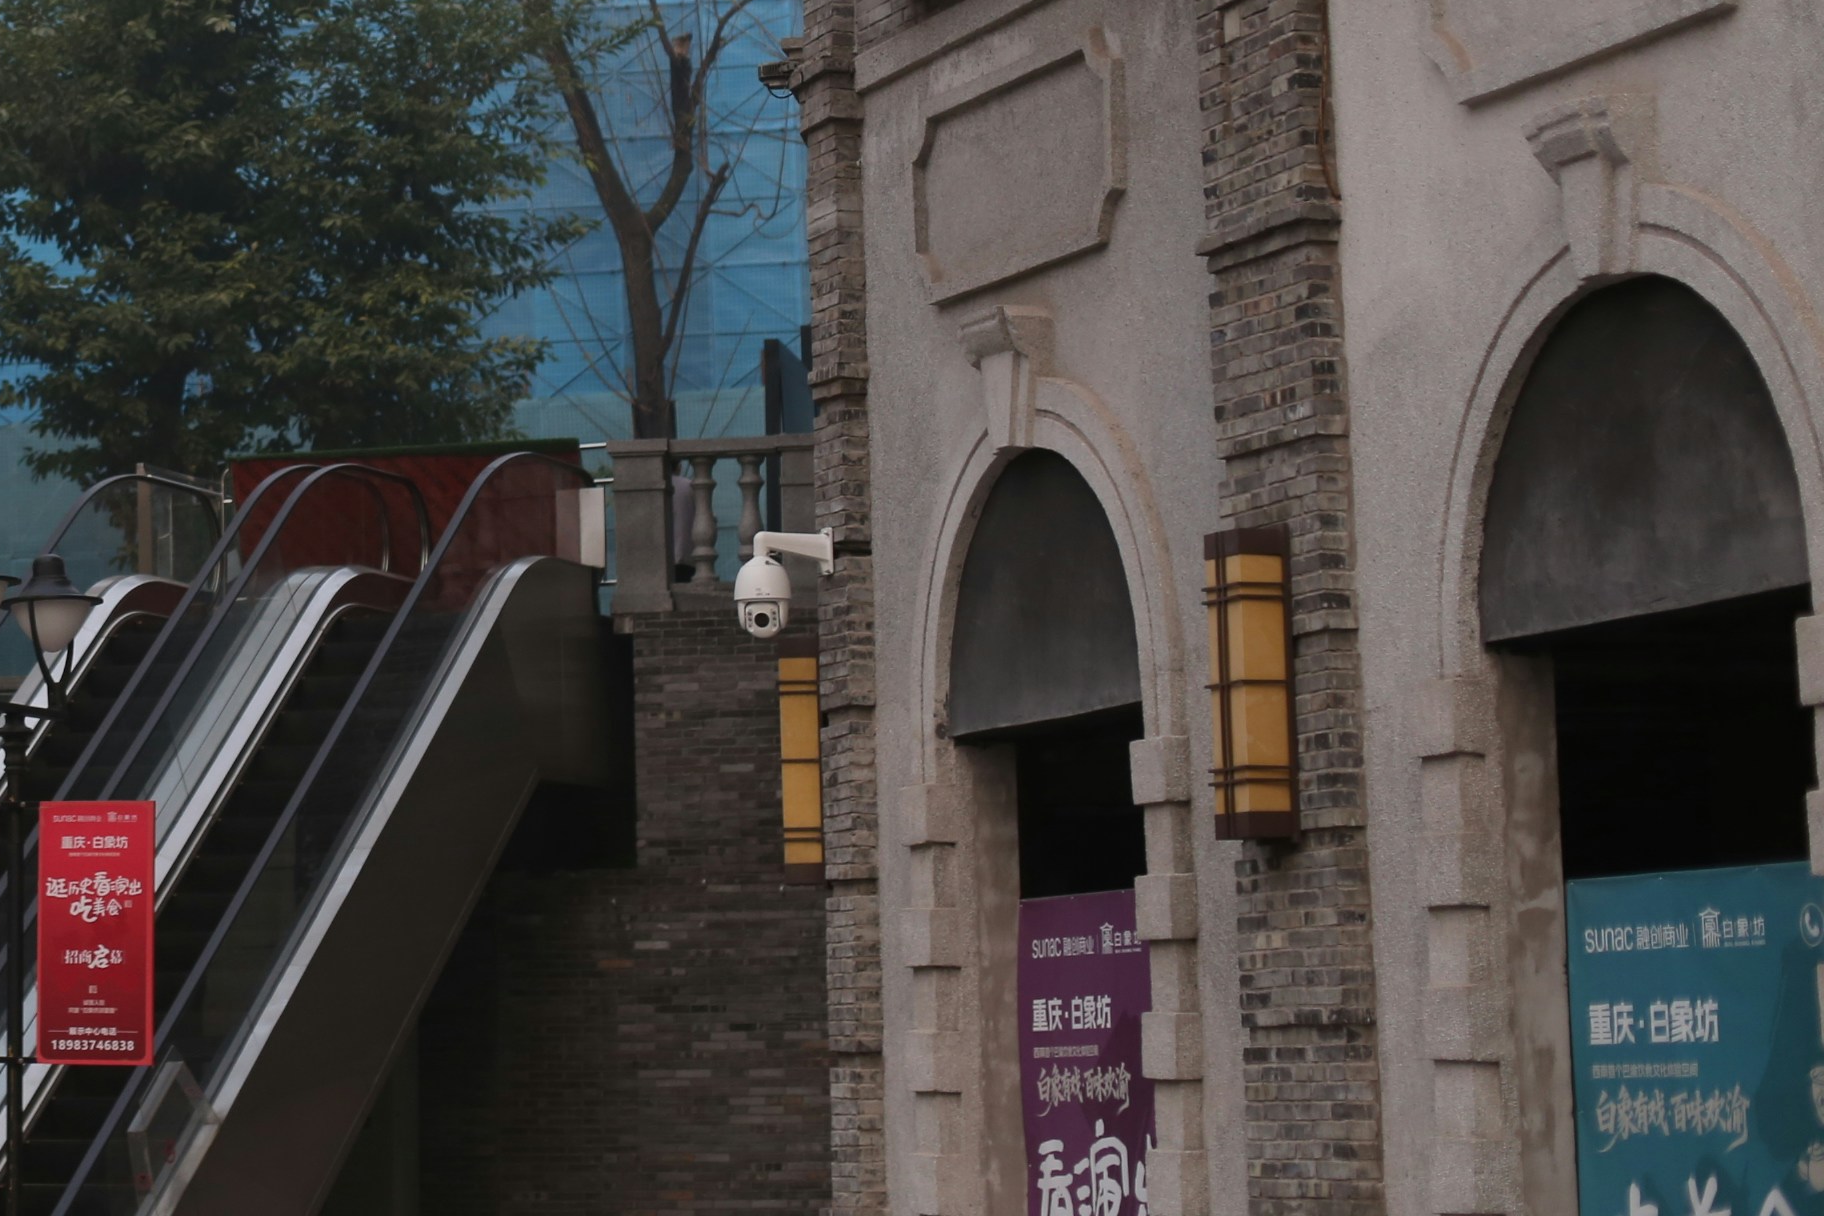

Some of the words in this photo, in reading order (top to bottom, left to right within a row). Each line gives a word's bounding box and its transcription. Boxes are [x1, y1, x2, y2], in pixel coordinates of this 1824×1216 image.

[69, 896, 123, 923] 吃美食
[1584, 926, 1633, 953] sunac
[1636, 922, 1689, 950] 融创商业
[1033, 995, 1111, 1032] 重庆·白象坊
[1589, 997, 1720, 1046] 重庆·白象坊
[51, 1040, 135, 1051] 18983746838
